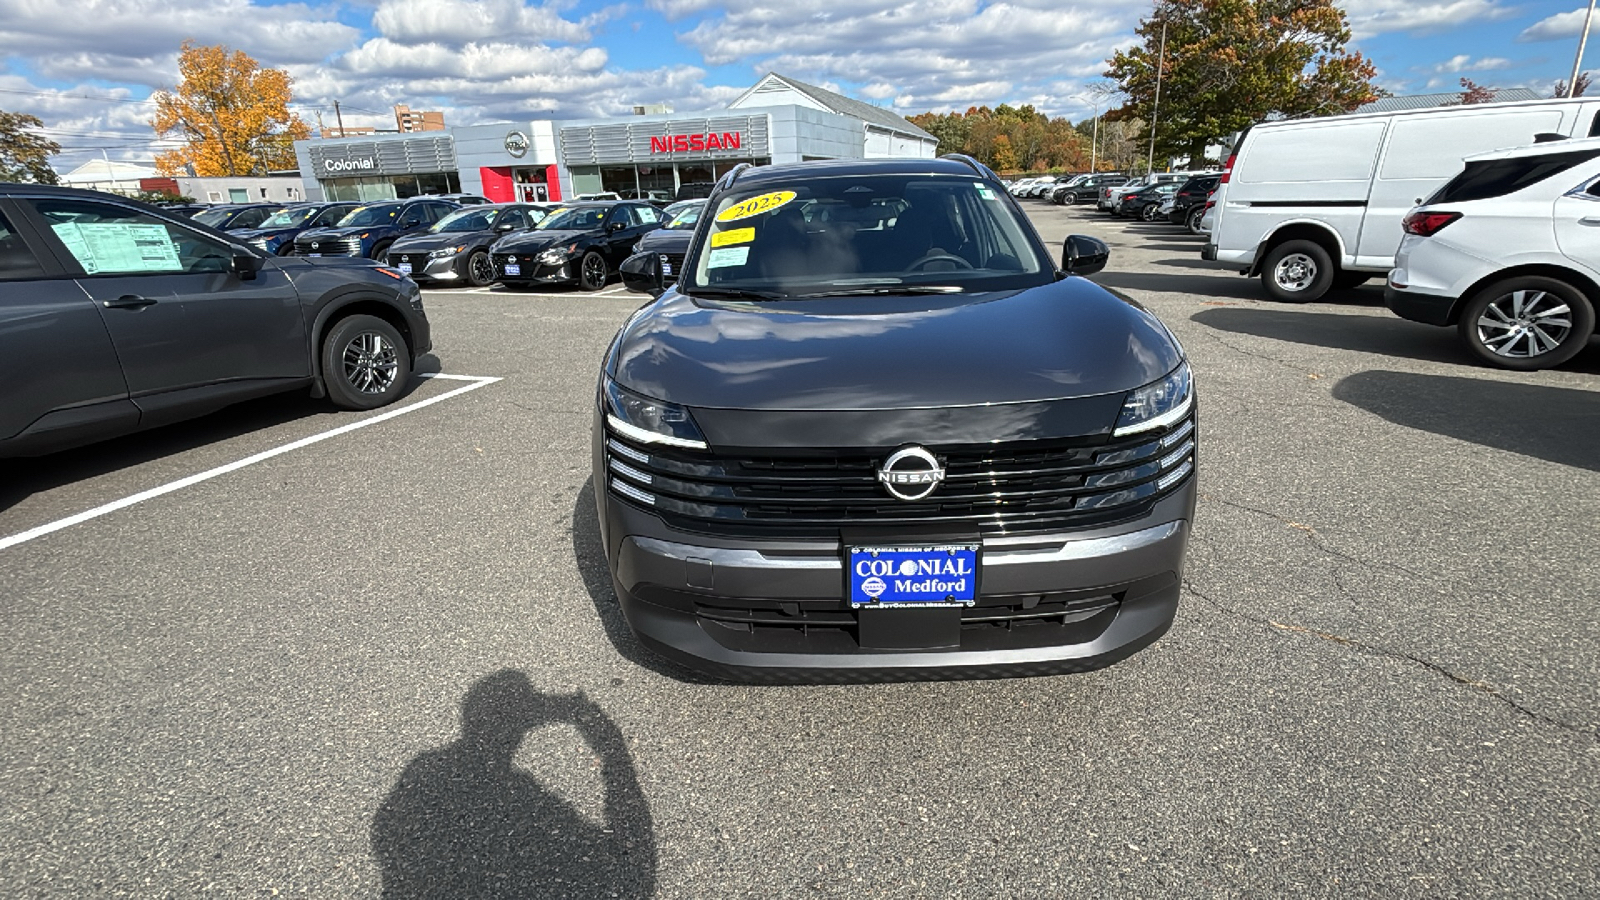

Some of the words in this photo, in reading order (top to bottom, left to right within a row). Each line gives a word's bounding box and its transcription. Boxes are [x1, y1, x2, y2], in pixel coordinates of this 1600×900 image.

[650, 131, 741, 154] NISSAN
[324, 156, 375, 171] Colonial
[734, 192, 783, 219] 2025
[879, 471, 944, 483] NISSAN
[856, 558, 972, 577] COLONIAL
[894, 578, 966, 593] Medford
